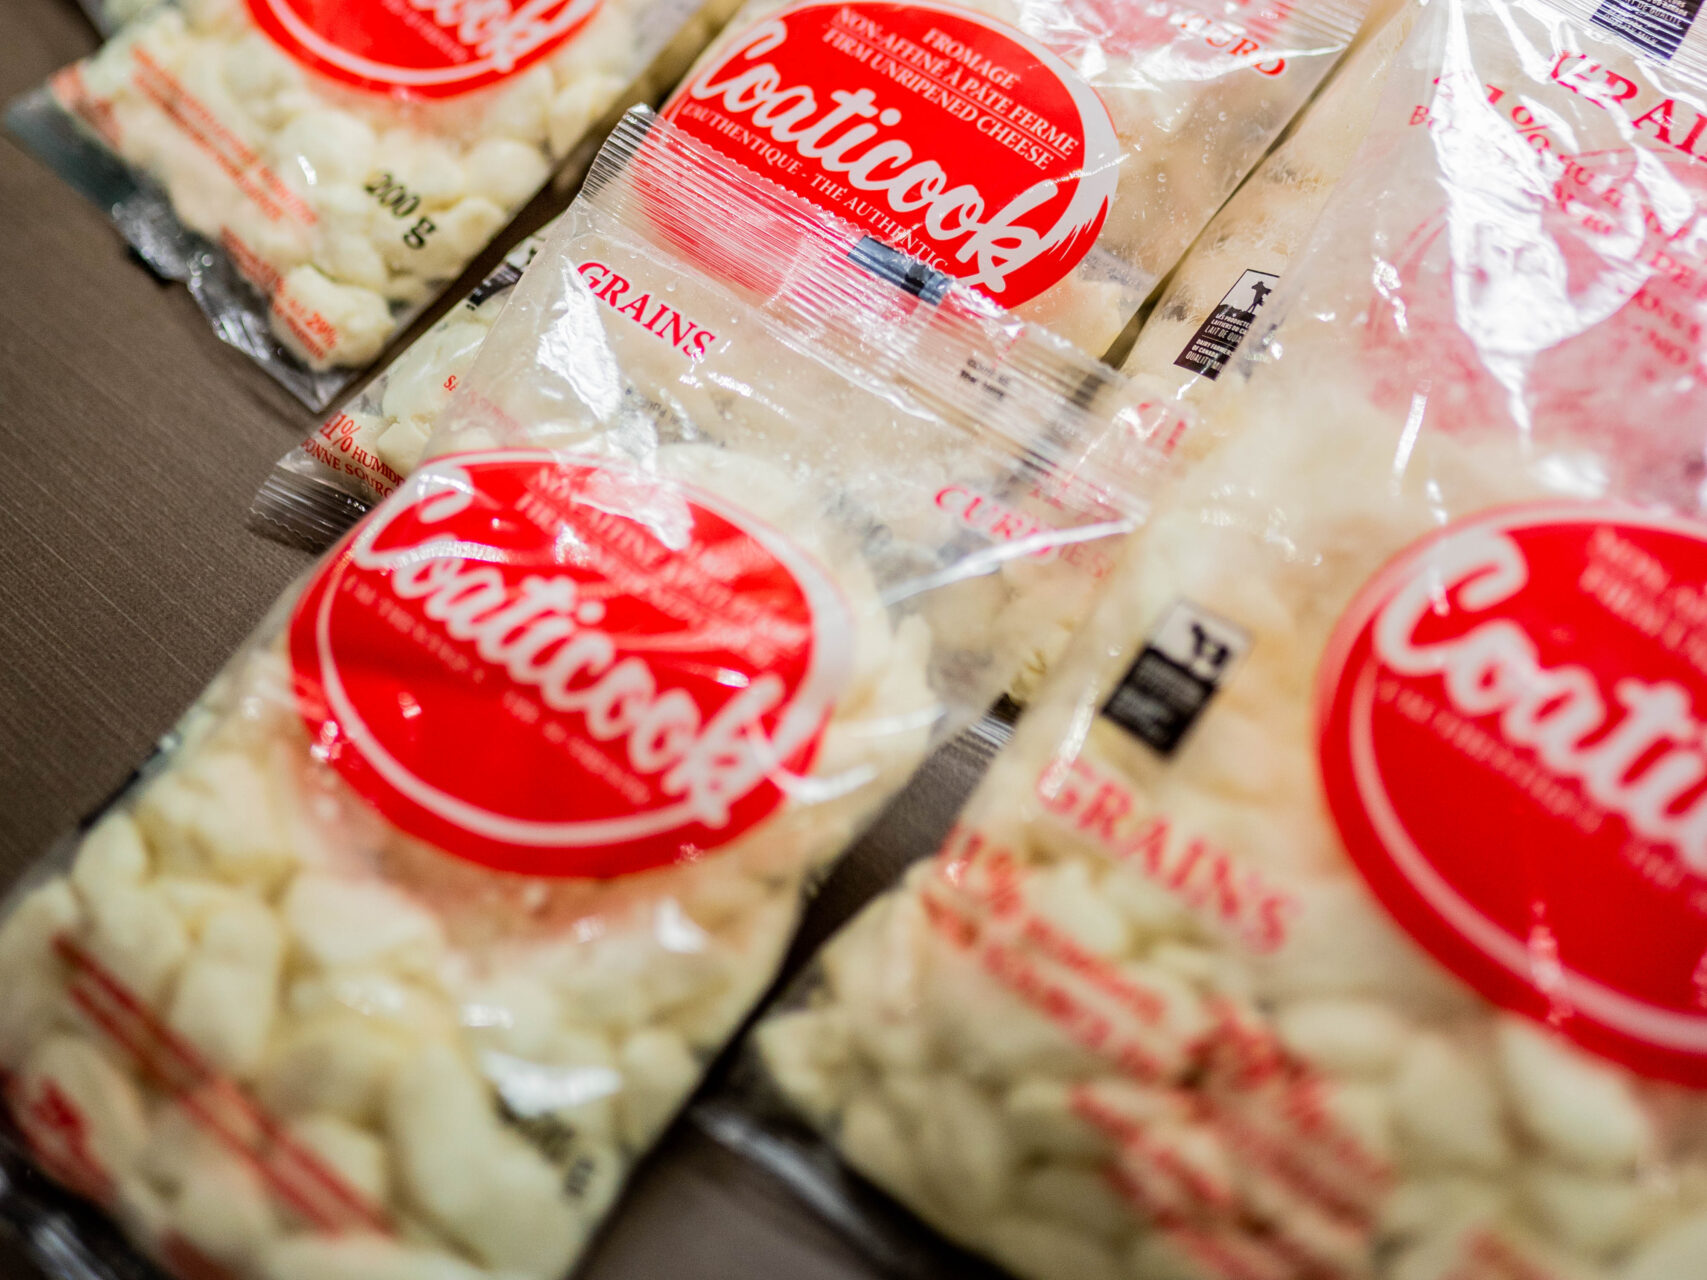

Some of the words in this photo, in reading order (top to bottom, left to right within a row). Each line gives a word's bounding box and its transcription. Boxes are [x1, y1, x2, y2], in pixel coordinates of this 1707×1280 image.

[822, 28, 874, 62] FIRM
[870, 53, 978, 122] UNRIPENED
[976, 115, 1054, 170] CHEESE
[831, 6, 951, 77] NON-AFFINÉ
[960, 77, 1014, 114] PÂTE
[1008, 104, 1079, 156] FERME
[922, 28, 1020, 90] FROMAGE
[690, 19, 1059, 293] Coaticook
[364, 173, 421, 218] 200
[402, 217, 436, 249] g
[810, 173, 848, 201] THE
[843, 196, 948, 271] AUTHENTIC
[577, 262, 716, 358] GRAINS
[1204, 325, 1220, 335] LAIT
[344, 463, 393, 499] SOURC
[353, 464, 785, 828] Coaticook
[1035, 756, 1292, 954] GRAINS
